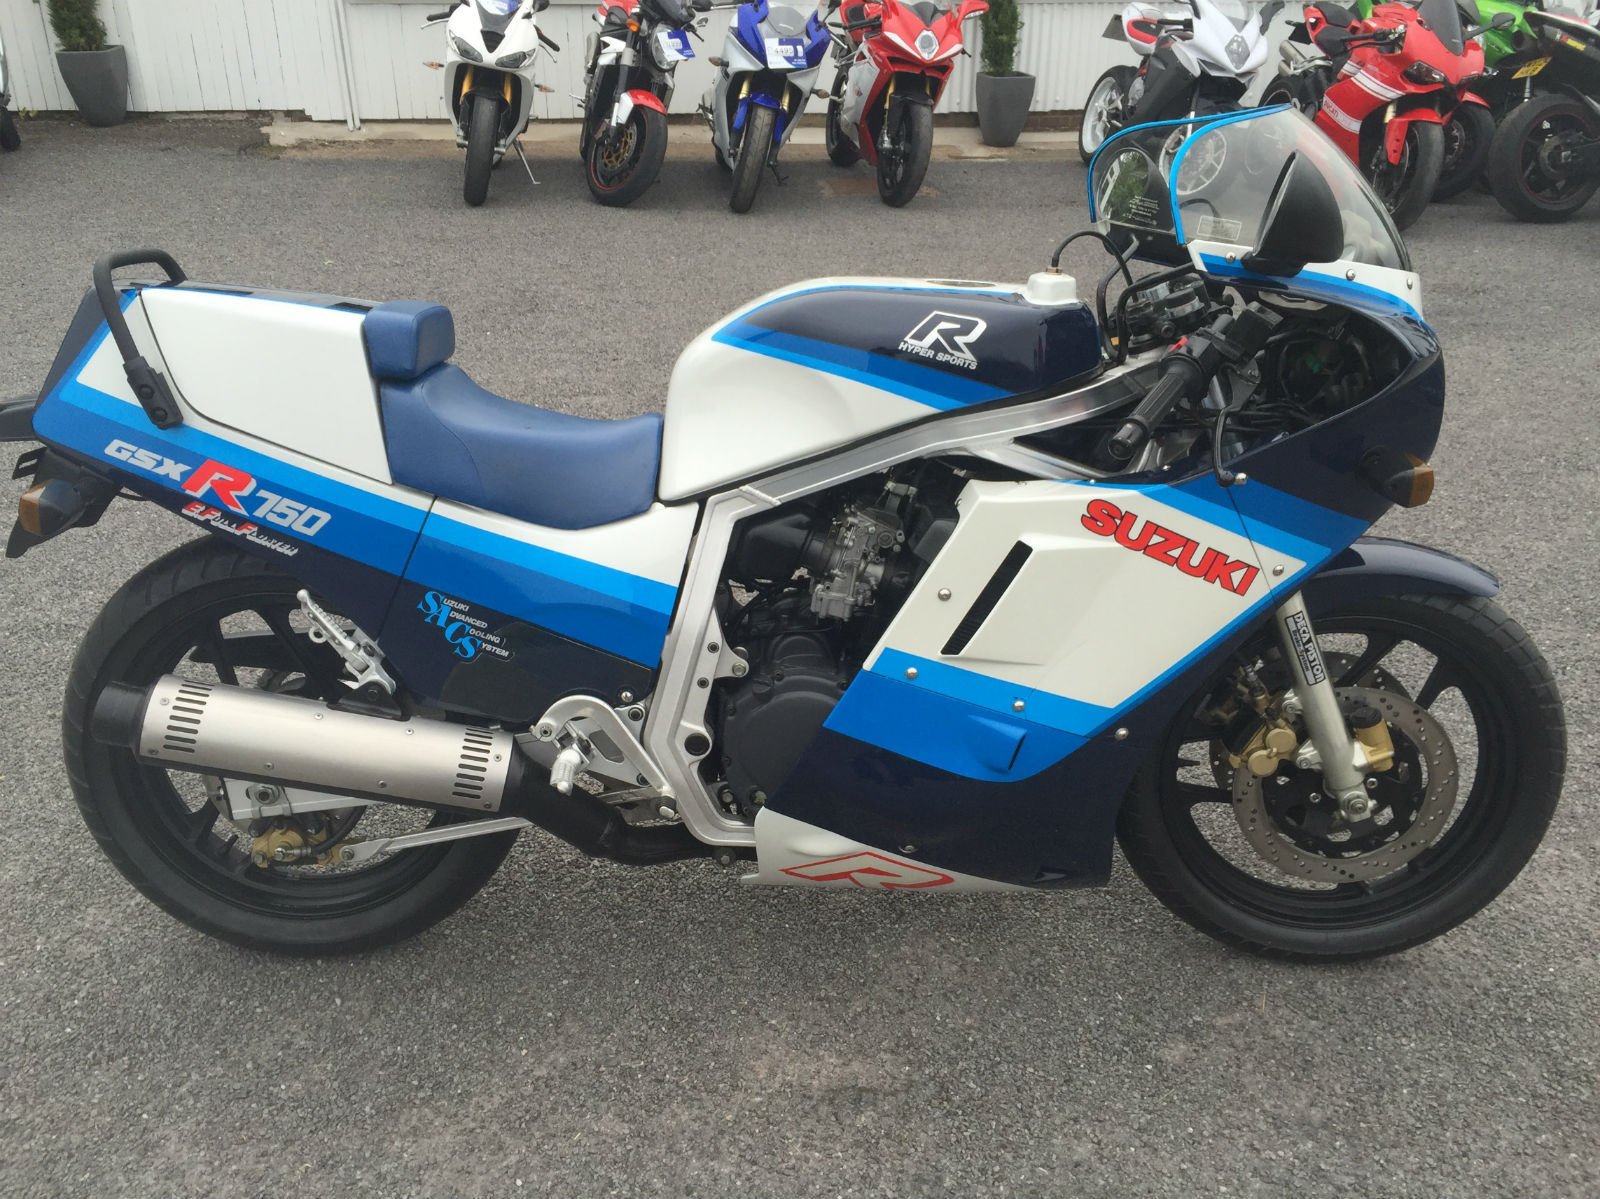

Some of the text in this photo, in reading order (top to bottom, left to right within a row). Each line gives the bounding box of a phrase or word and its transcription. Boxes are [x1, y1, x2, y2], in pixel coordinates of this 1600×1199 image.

[898, 341, 978, 370] HYPER SPORTS
[903, 309, 988, 361] R
[104, 439, 192, 482] GSX
[253, 489, 332, 537] 750
[1080, 498, 1260, 597] SUZUKI
[1293, 612, 1326, 682] DECA PISTON
